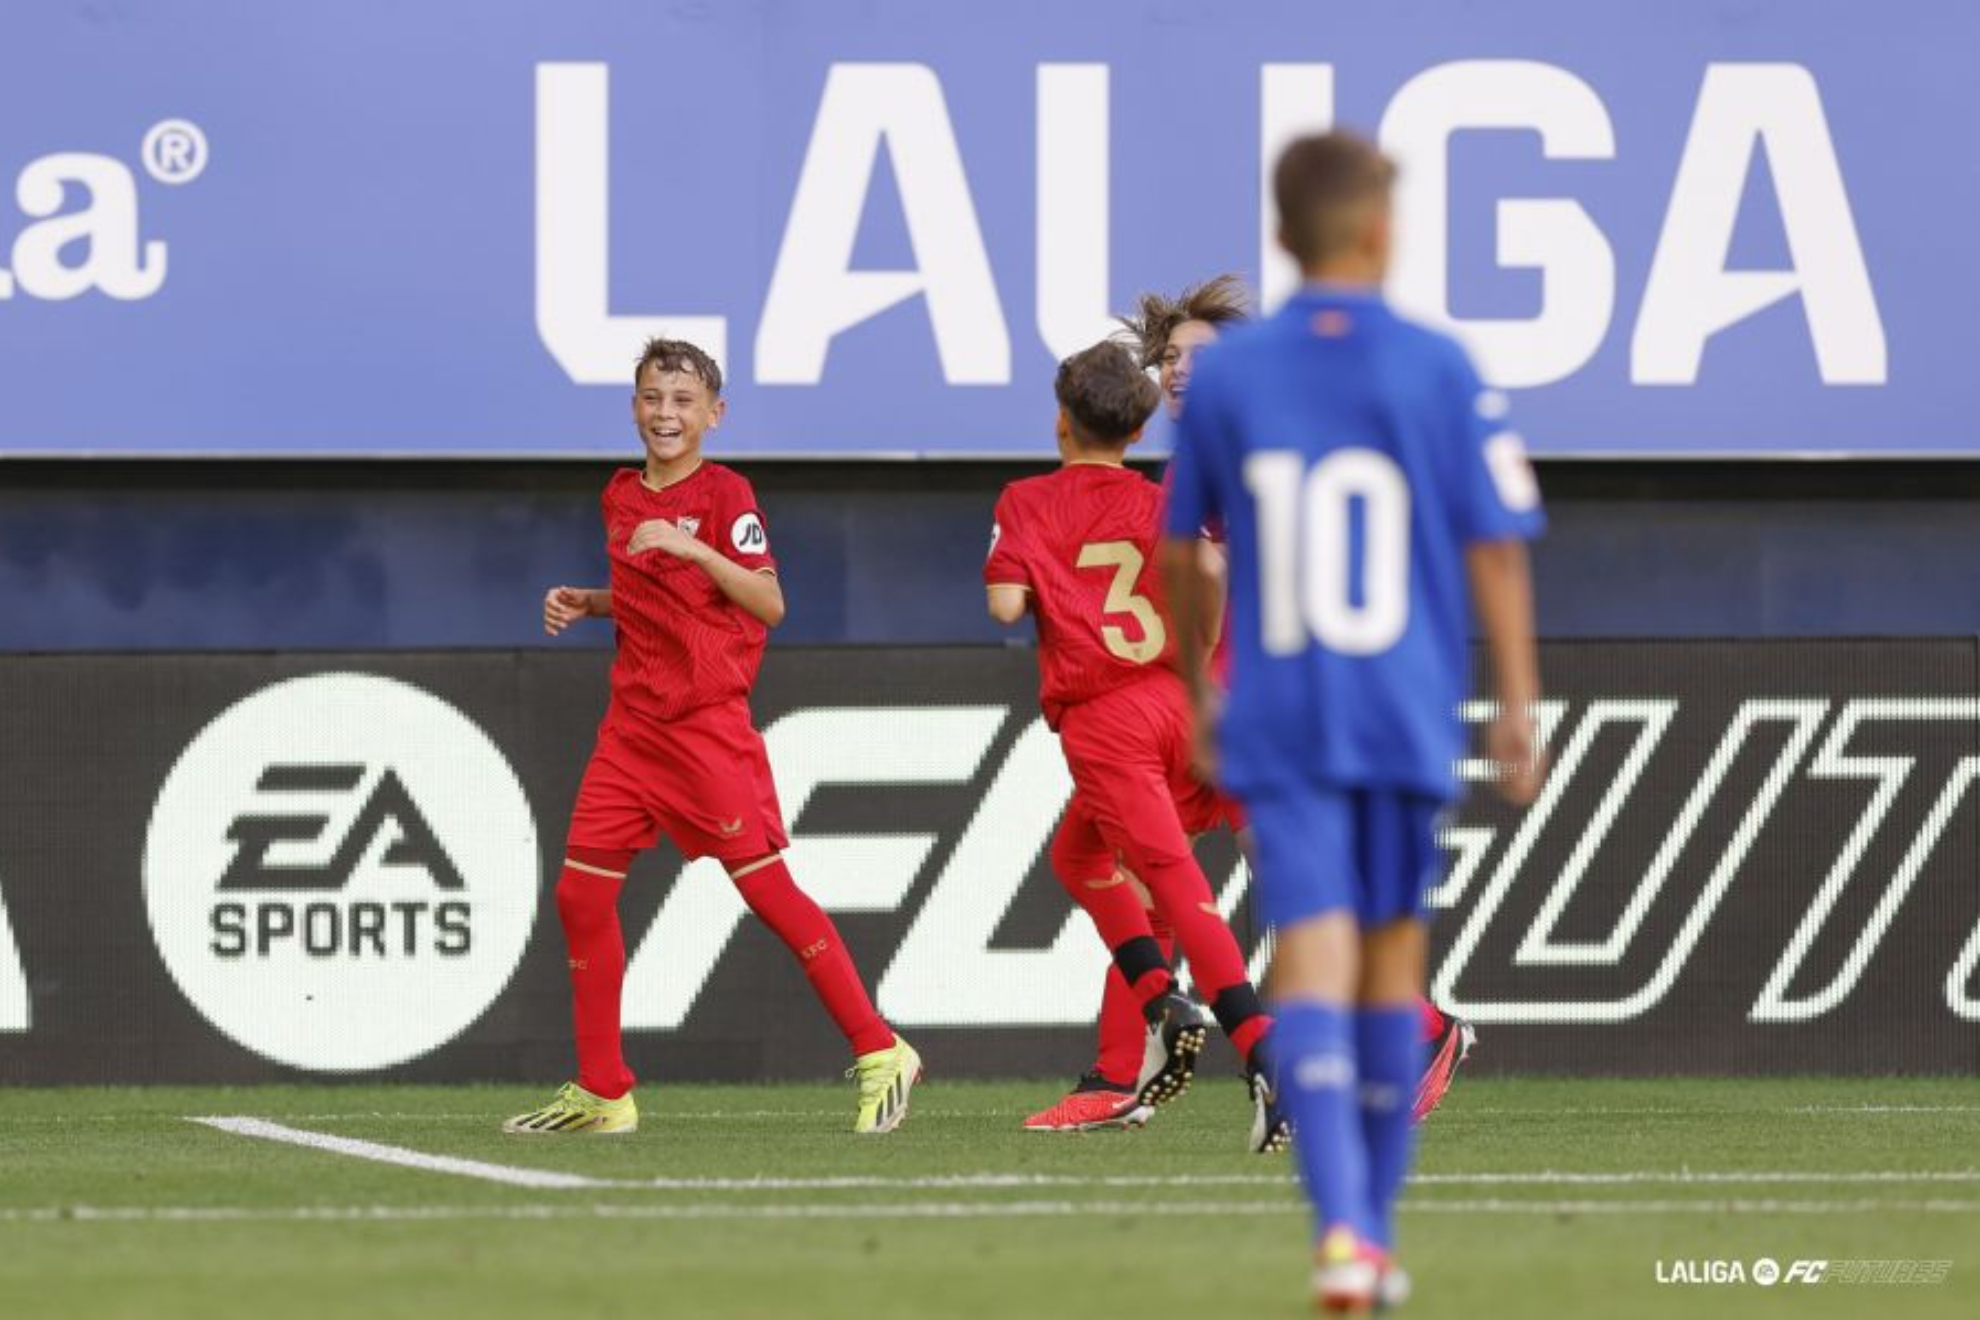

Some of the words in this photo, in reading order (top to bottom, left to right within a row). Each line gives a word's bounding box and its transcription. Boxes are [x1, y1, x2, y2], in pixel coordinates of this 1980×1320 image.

[739, 522, 763, 546] JD
[1243, 446, 1412, 658] 10
[1076, 540, 1167, 665] 3
[215, 763, 467, 890] EA
[209, 901, 472, 960] SPORTS
